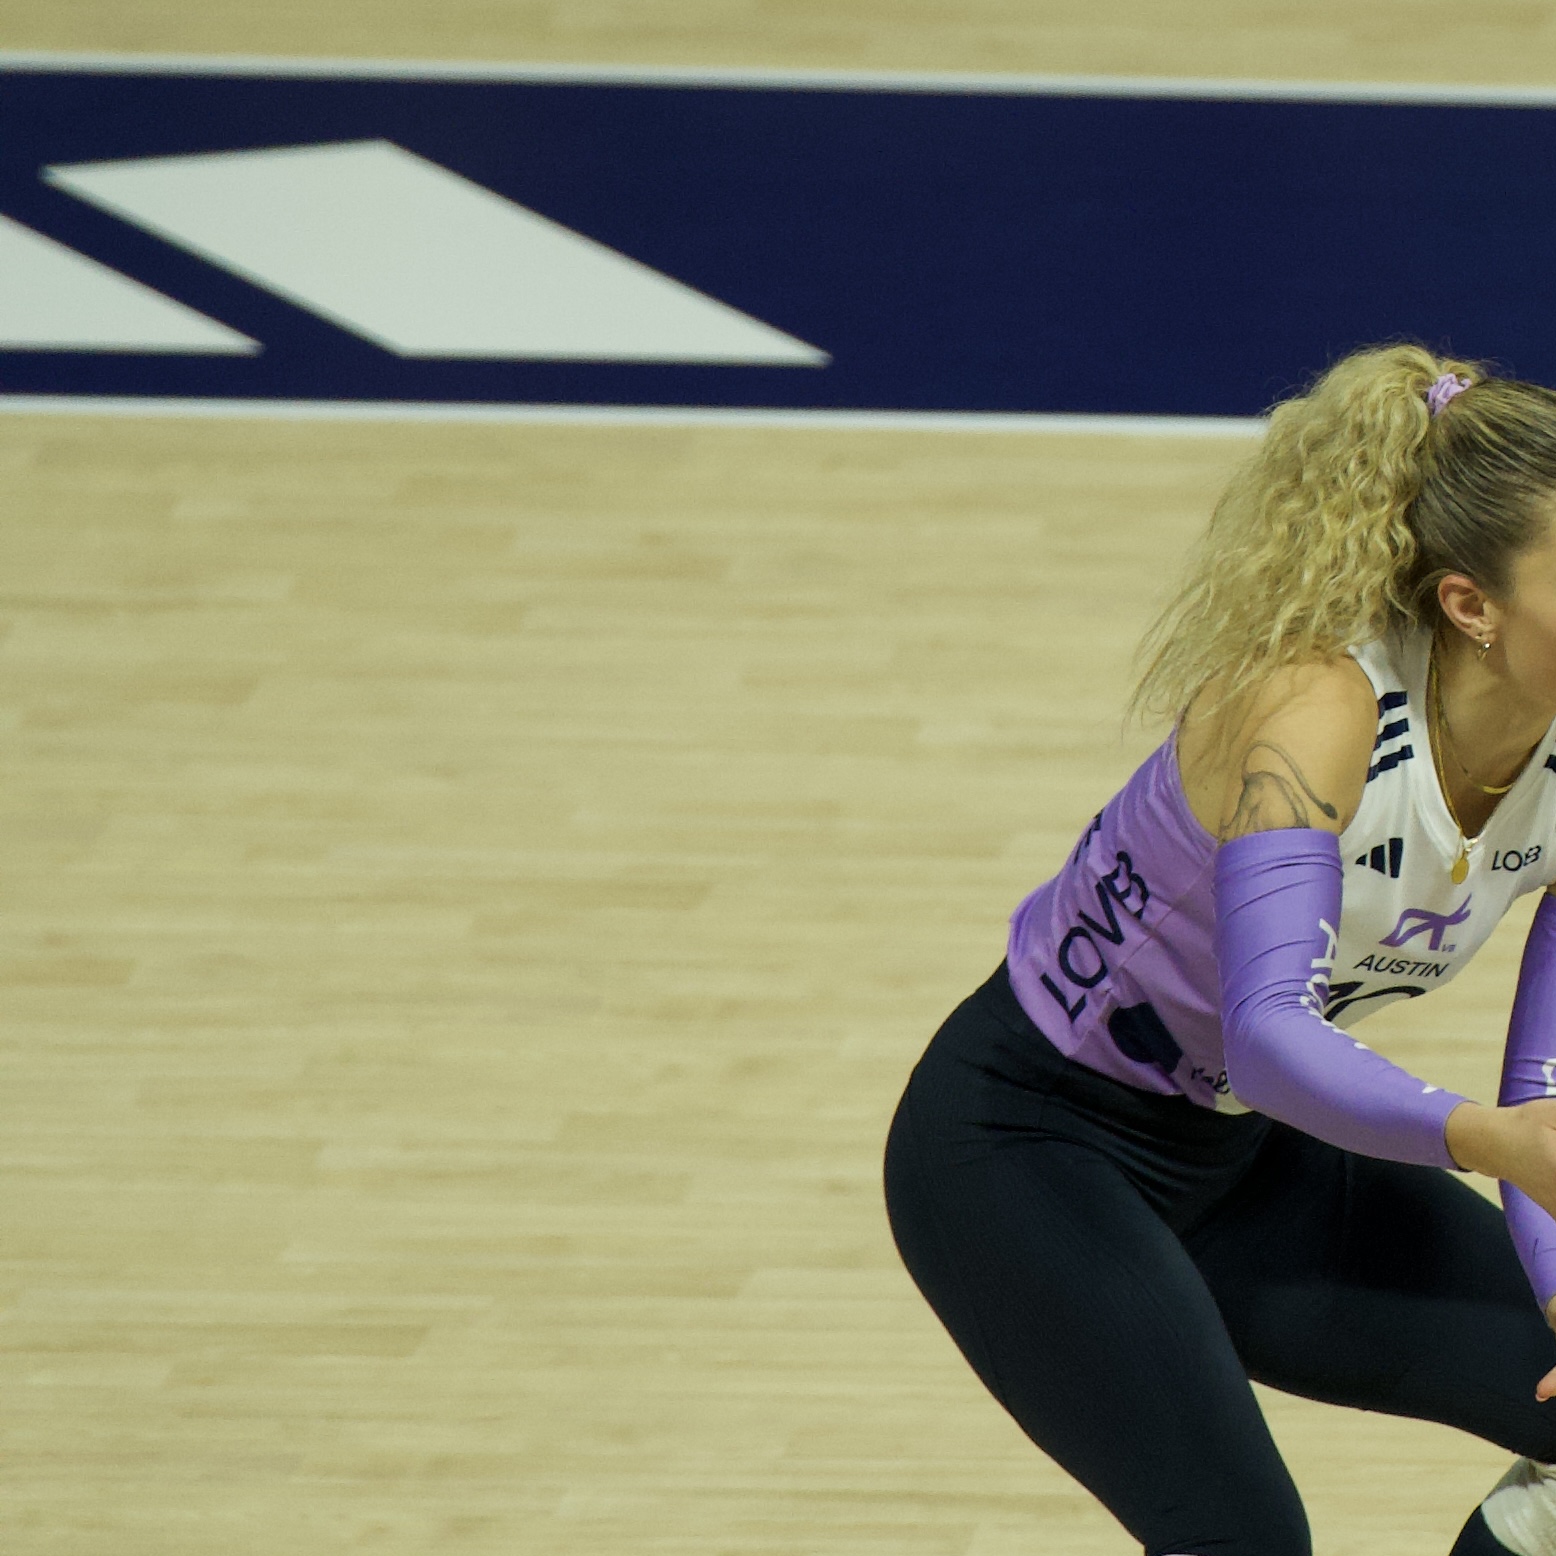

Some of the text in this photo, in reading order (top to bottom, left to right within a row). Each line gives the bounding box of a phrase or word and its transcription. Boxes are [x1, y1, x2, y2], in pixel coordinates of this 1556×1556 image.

[1490, 844, 1542, 872] LOB
[1040, 850, 1150, 1025] LOVB
[1353, 953, 1450, 978] AUSTIN
